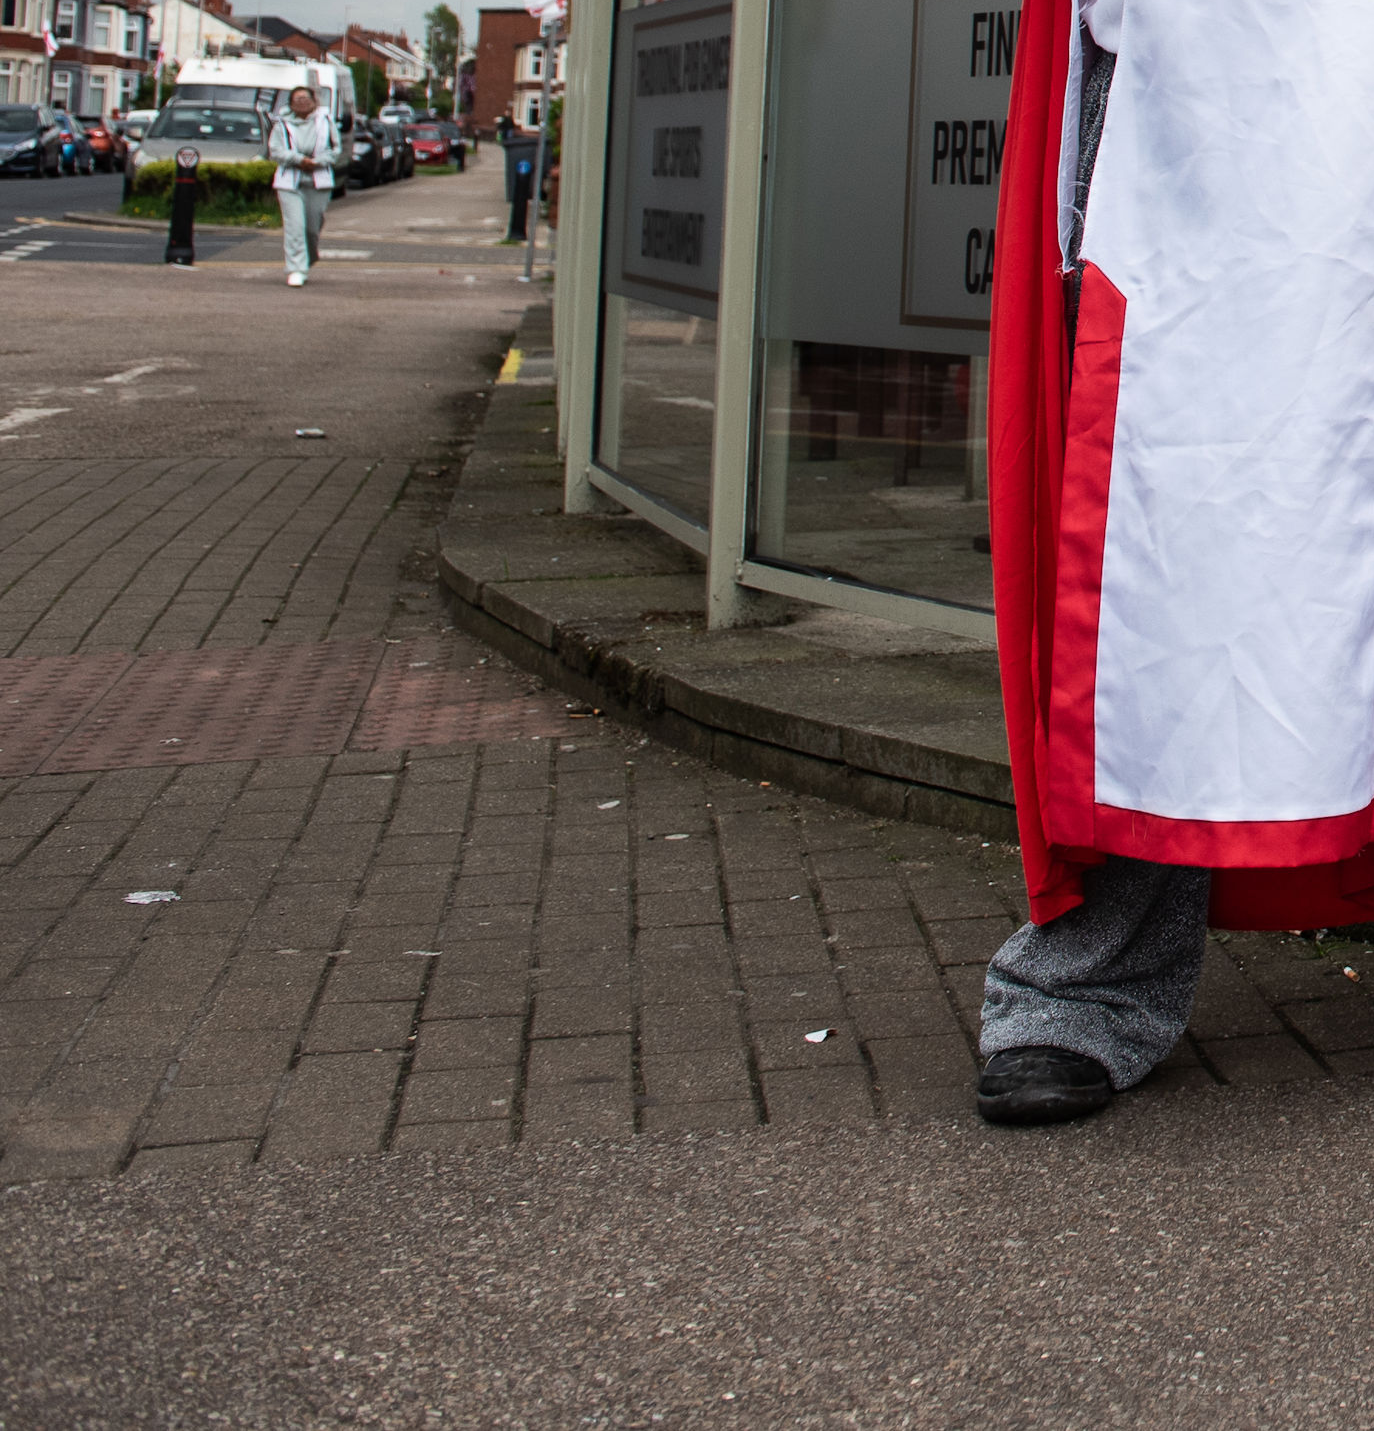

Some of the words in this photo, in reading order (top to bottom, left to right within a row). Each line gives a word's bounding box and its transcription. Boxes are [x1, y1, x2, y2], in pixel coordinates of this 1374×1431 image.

[970, 10, 1021, 77] FIN
[932, 119, 1007, 184] PREM
[965, 227, 995, 294] CA
